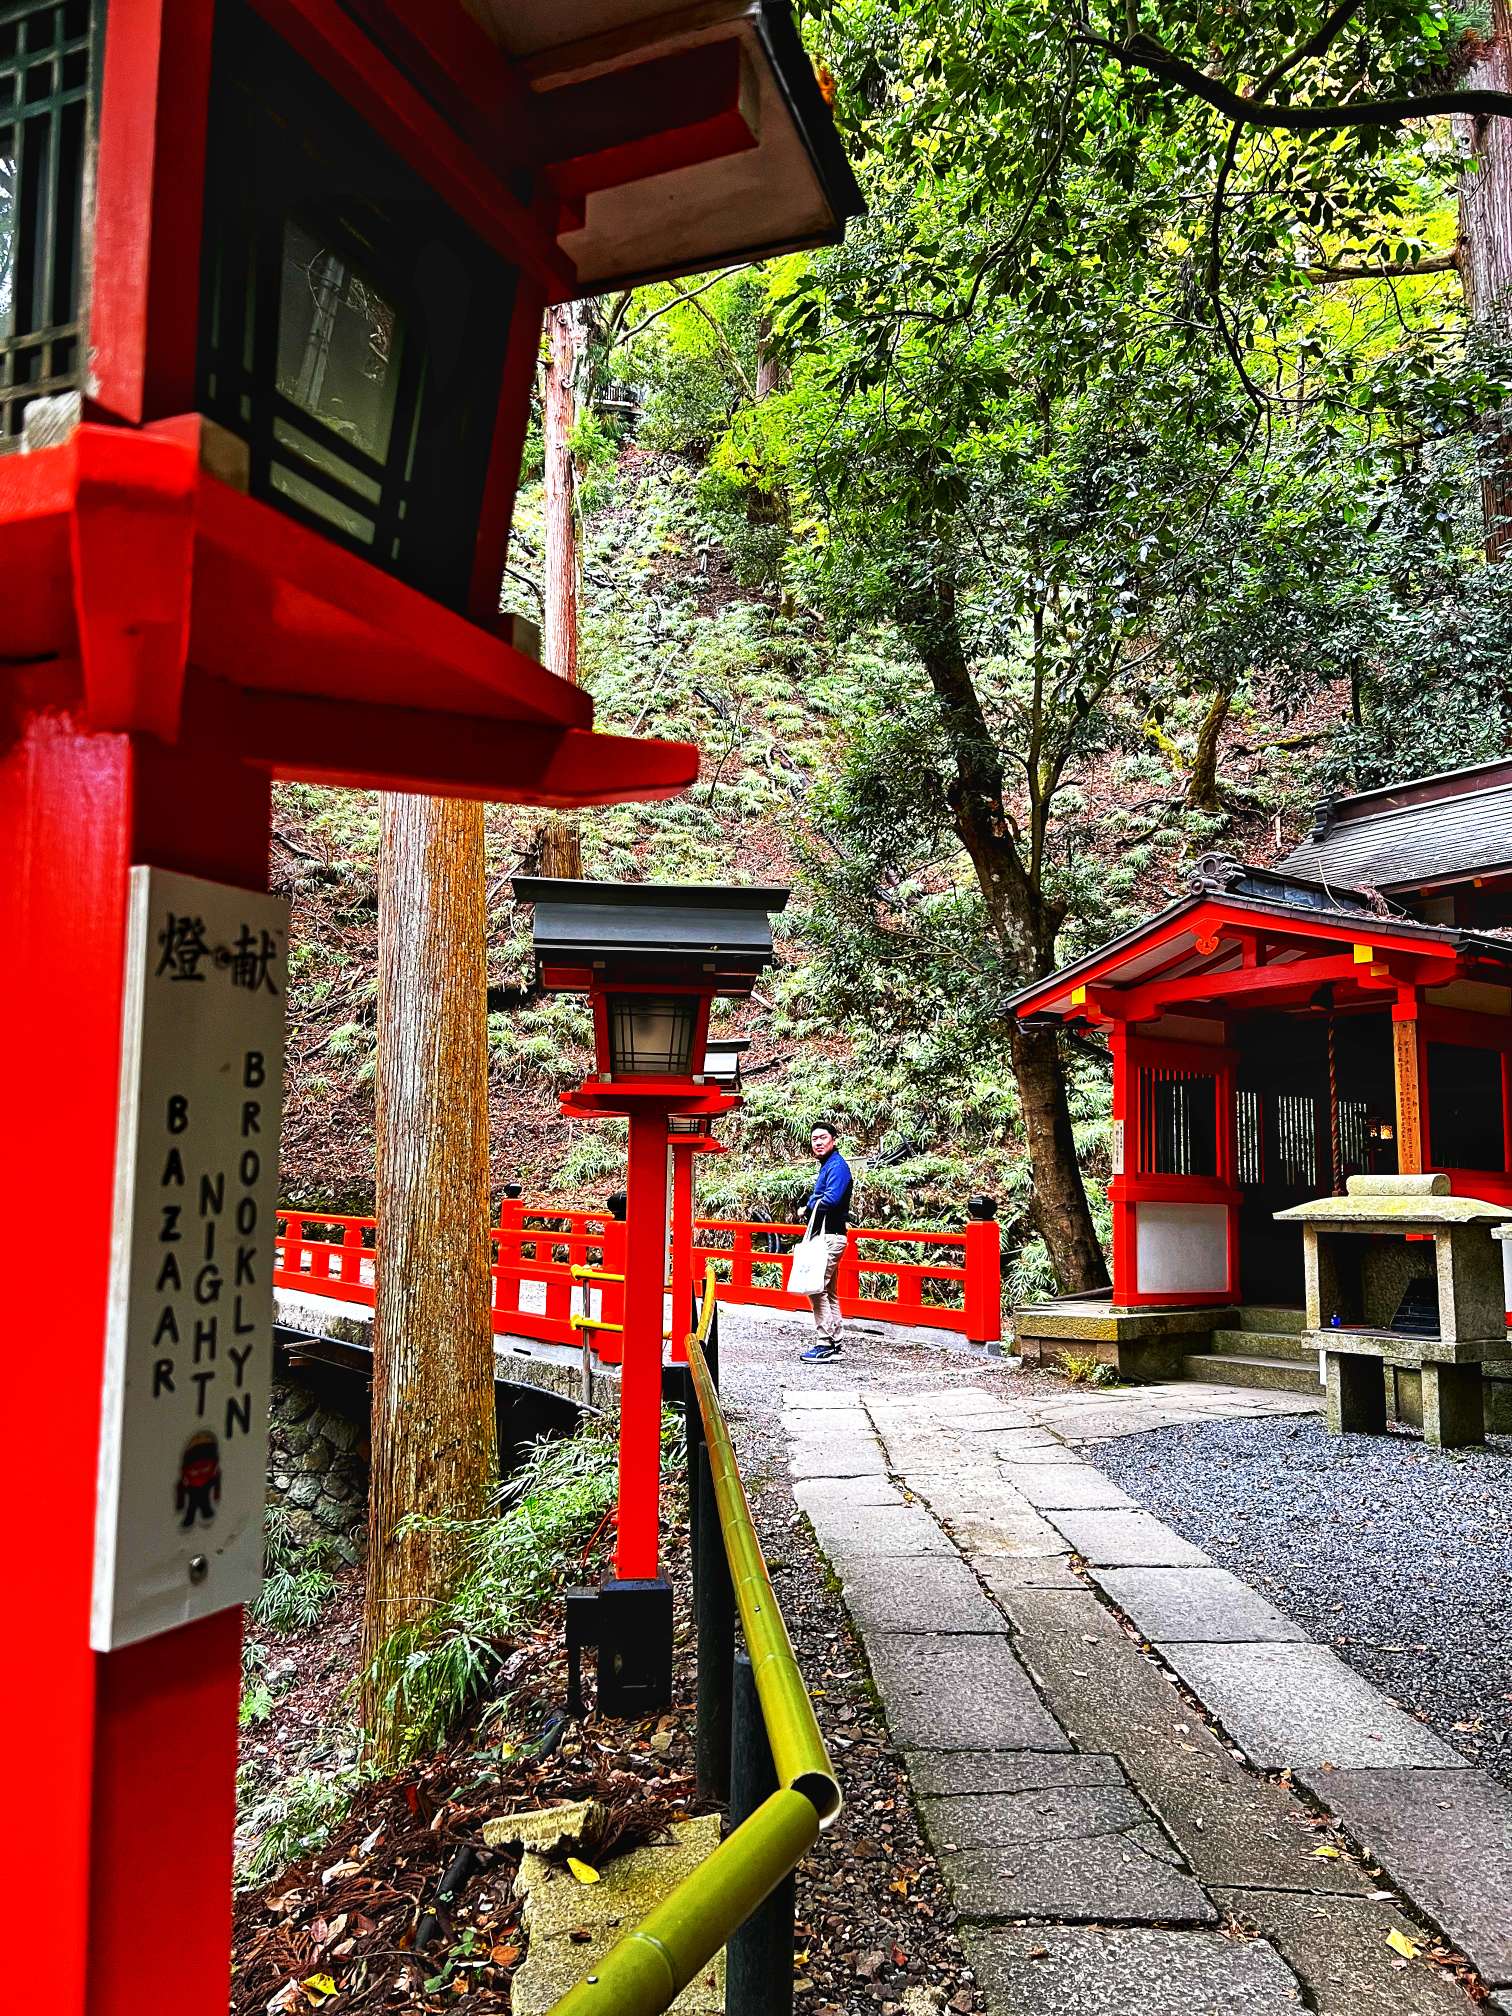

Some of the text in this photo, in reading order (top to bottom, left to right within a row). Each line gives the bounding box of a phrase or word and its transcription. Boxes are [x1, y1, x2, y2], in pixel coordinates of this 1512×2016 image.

[151, 1094, 190, 1398] BAZAAR
[192, 1172, 225, 1417] NIGHT
[225, 1051, 266, 1440] BROOKLYN
